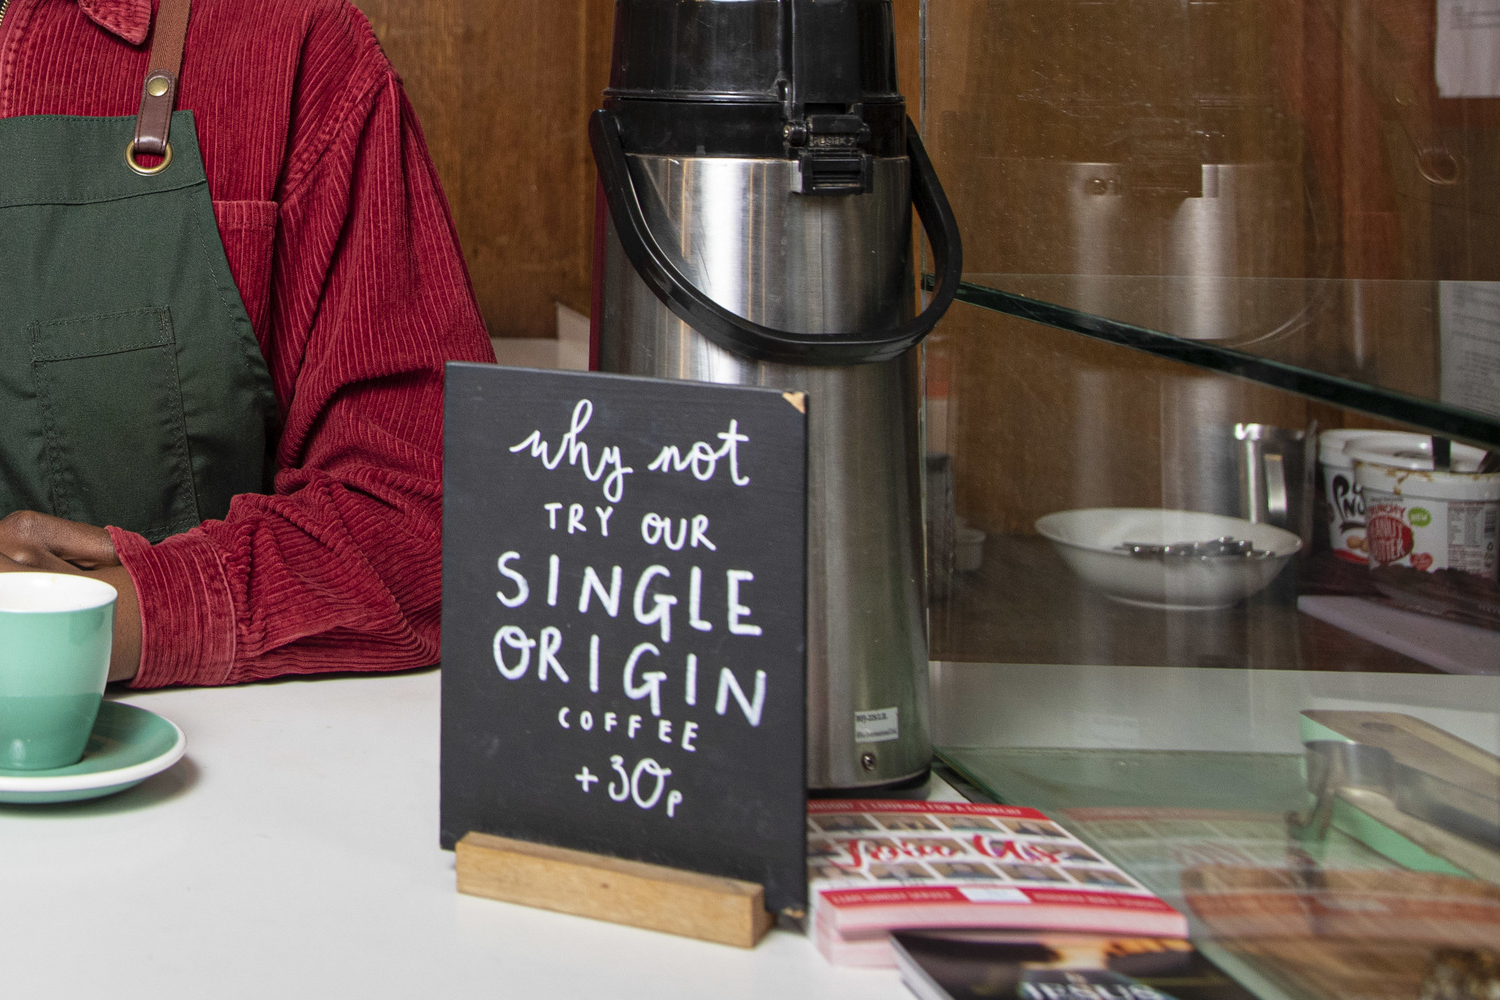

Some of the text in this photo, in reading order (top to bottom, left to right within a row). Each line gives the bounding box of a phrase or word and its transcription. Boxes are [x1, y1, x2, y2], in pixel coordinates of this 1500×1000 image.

[508, 398, 750, 504] why not
[543, 500, 717, 551] TRY OUR
[494, 548, 763, 645] SINGLE
[492, 622, 767, 729] ORIGIN
[557, 704, 699, 752] COFFEE
